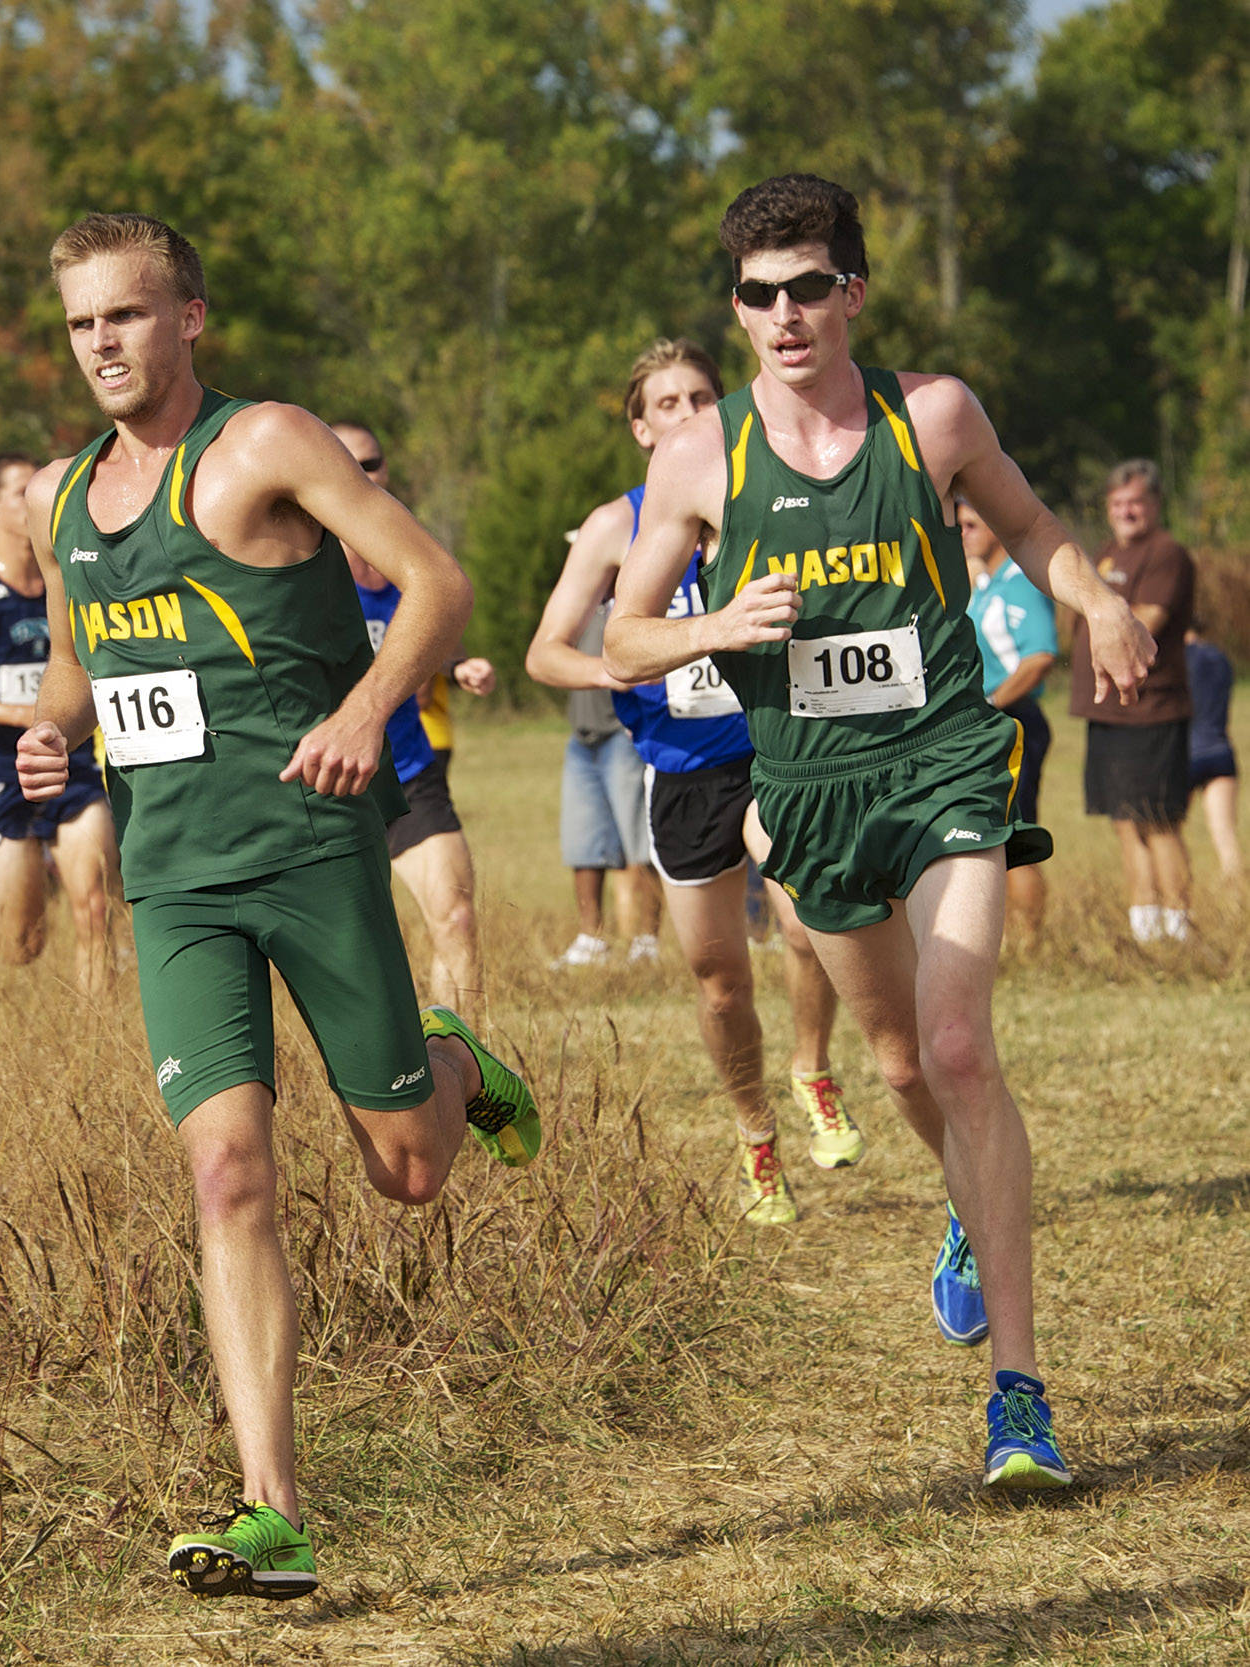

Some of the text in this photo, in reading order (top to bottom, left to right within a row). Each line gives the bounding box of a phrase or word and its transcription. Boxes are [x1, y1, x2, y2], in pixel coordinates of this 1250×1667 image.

[784, 496, 810, 509] asics
[75, 549, 99, 562] asics
[766, 540, 906, 593] MASON
[813, 643, 894, 688] 108
[108, 685, 176, 733] 116
[406, 1066, 426, 1085] asics
